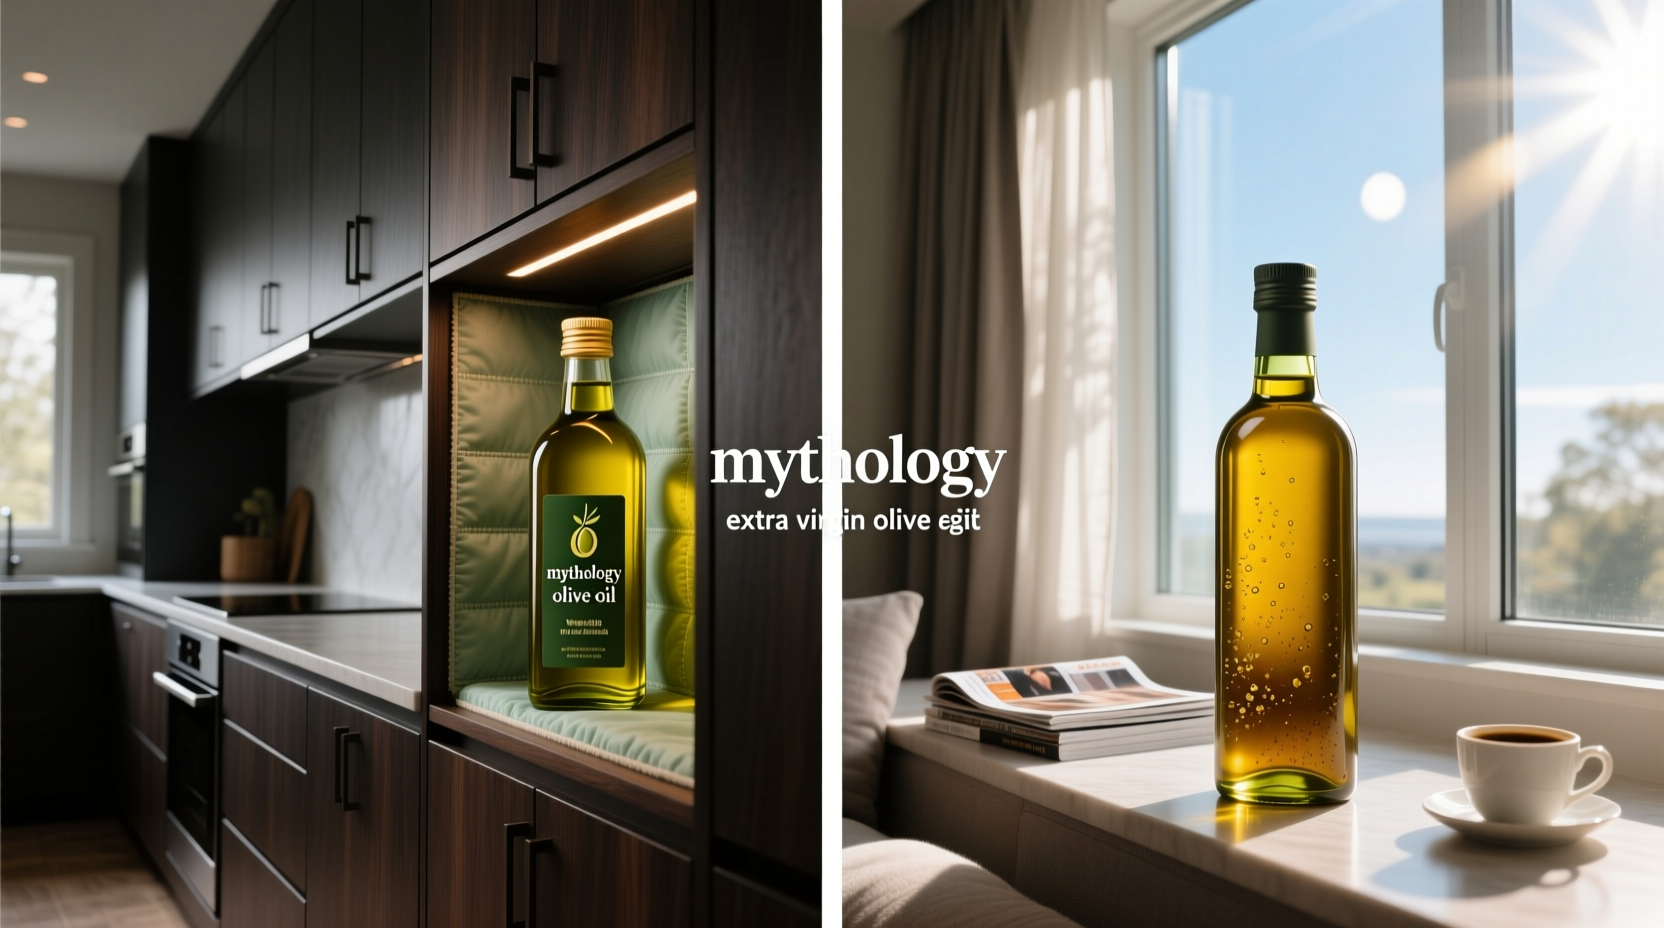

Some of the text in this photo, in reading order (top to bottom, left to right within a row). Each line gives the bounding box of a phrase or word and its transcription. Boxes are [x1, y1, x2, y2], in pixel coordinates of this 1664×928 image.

[546, 564, 622, 584] mythology
[552, 586, 616, 603] olive oil
